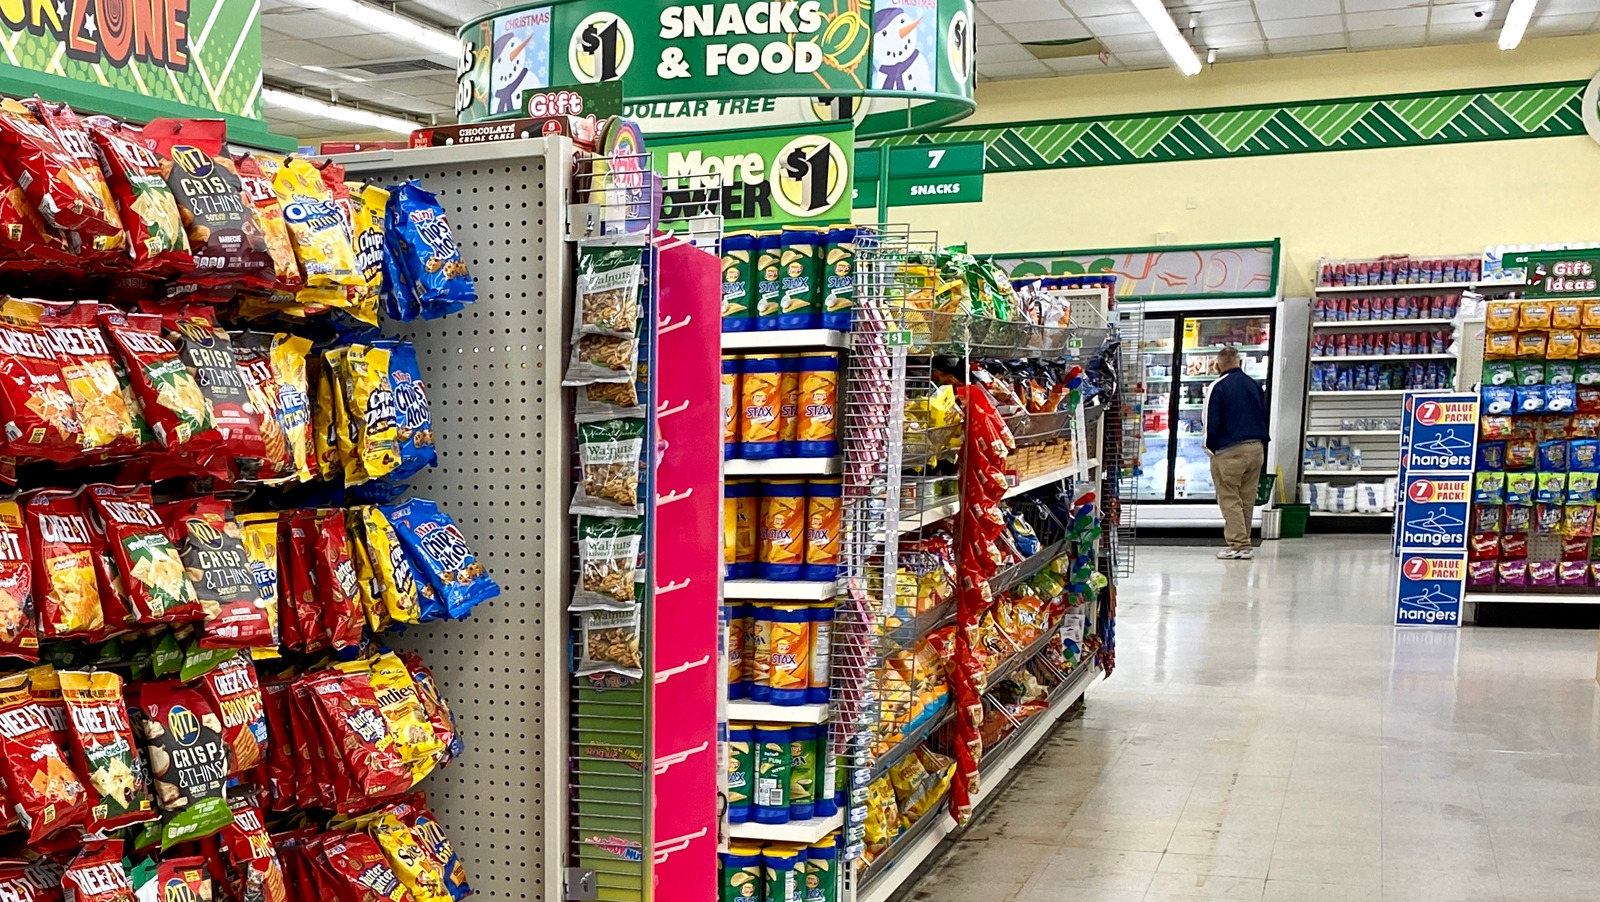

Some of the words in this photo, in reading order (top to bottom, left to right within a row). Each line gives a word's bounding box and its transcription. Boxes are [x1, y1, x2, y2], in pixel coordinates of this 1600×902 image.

[504, 12, 551, 31] CHRISTMAS
[659, 0, 822, 39] SNACKS
[69, 0, 188, 66] ZONE
[577, 18, 619, 81] $1
[657, 46, 692, 79] &
[706, 41, 823, 77] FOOD
[530, 91, 582, 118] Gift
[622, 99, 708, 119] DOLLAR
[719, 97, 777, 114] TREE
[459, 123, 516, 137] CHOCOLATE
[547, 122, 556, 132] 5
[174, 147, 210, 174] RITZ
[927, 150, 947, 168] 7
[667, 150, 765, 190] More
[779, 142, 831, 212] $1
[910, 183, 961, 196] SNACKS
[660, 180, 772, 223] OWER
[417, 221, 449, 244] hips
[1554, 263, 1592, 276] Gift
[782, 276, 810, 290] STAX
[1546, 278, 1596, 291] Ideas
[189, 348, 233, 369] CRISP
[745, 405, 774, 418] STAX
[805, 405, 833, 417] STAX
[1423, 403, 1437, 419] 7
[1445, 403, 1474, 413] VALUE
[1444, 413, 1473, 423] PACK!
[1412, 453, 1471, 469] hangers
[1415, 482, 1429, 497] 7
[1437, 481, 1466, 491] VALUE
[1437, 491, 1465, 501] PACK!
[1404, 531, 1463, 547] hangers
[198, 551, 241, 569] CRISP
[1410, 559, 1424, 575] 7
[1431, 560, 1460, 570] VALUE
[252, 569, 277, 584] REO
[1431, 569, 1459, 579] PACK!
[1399, 607, 1457, 624] hangers
[772, 653, 797, 666] STAX
[377, 684, 416, 708] andies
[170, 708, 199, 743] RITZ
[173, 740, 221, 768] CRISP
